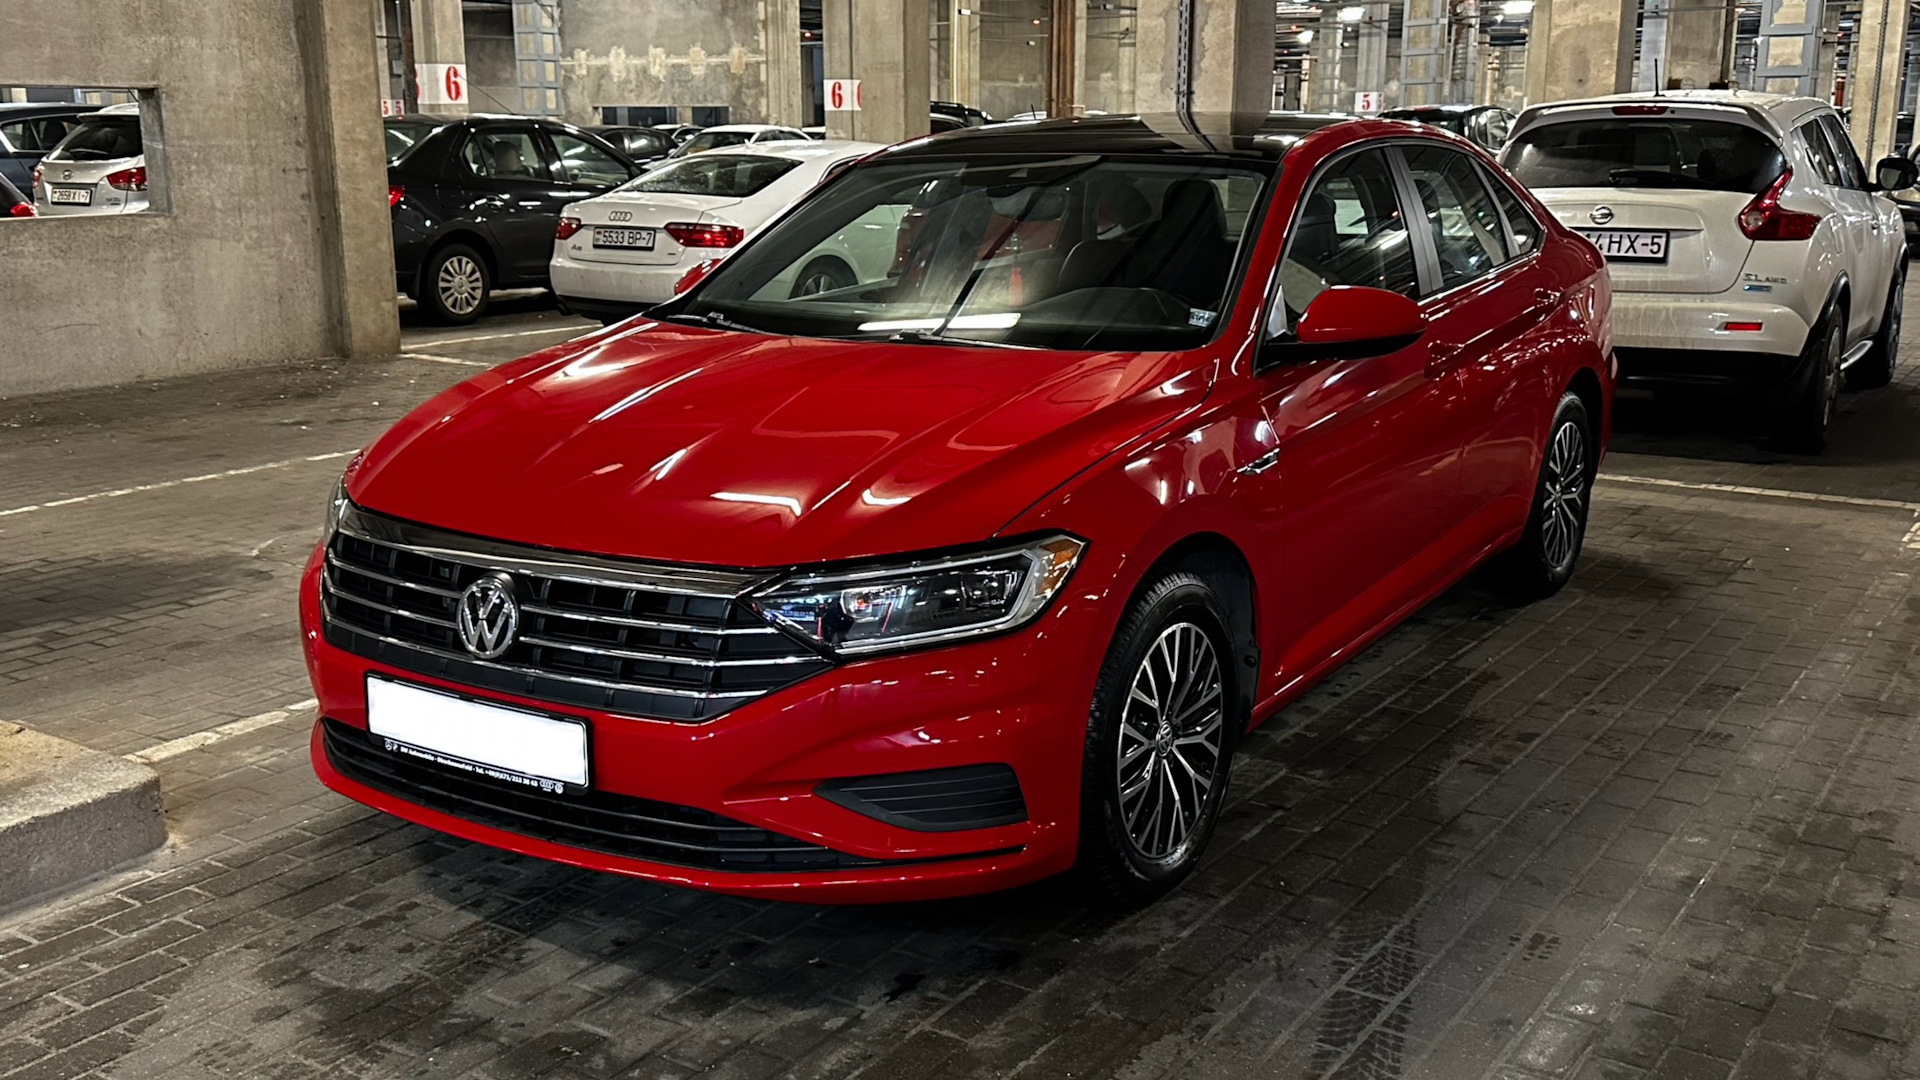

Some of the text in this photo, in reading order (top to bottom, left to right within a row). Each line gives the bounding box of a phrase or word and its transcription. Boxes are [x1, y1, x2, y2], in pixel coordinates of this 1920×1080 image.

[446, 66, 461, 101] 6
[831, 81, 843, 109] 6
[1362, 93, 1370, 110] 5
[602, 229, 653, 245] 5533 BP-7
